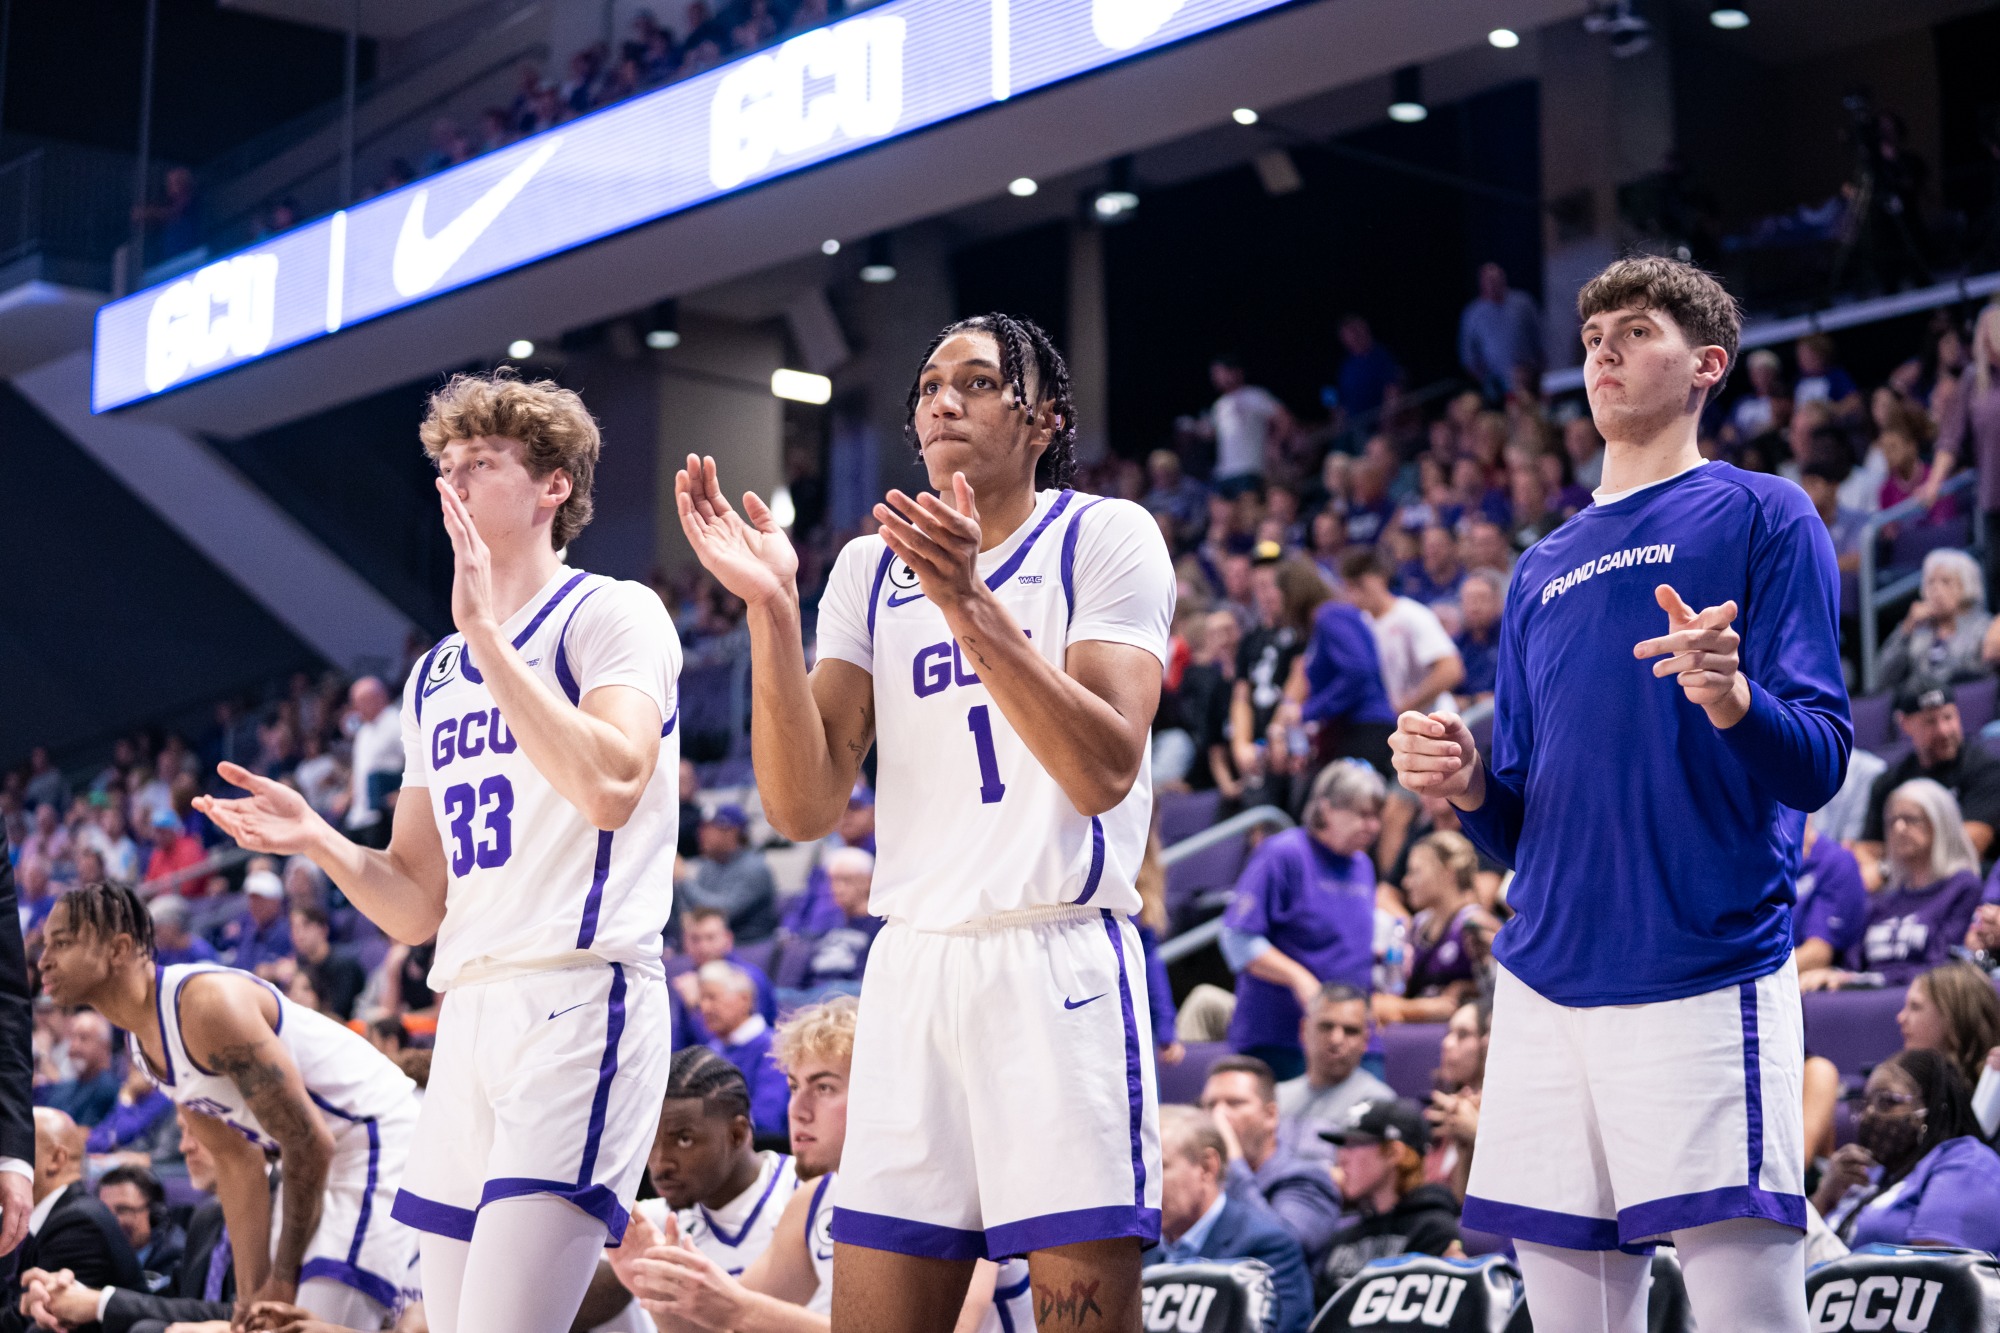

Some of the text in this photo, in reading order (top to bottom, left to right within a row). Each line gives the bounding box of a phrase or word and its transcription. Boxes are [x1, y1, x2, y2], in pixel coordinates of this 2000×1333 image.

[709, 15, 907, 190] GCU
[145, 253, 279, 393] GCU
[1018, 575, 1042, 585] WAC
[1541, 543, 1676, 606] GRAND CANYON
[437, 651, 453, 673] 4
[432, 707, 518, 772] GCU
[967, 704, 1006, 804] 1
[444, 774, 514, 878] 33
[1035, 1280, 1103, 1327] DMX
[1348, 1273, 1467, 1328] GCU
[1808, 1275, 1944, 1333] GCU
